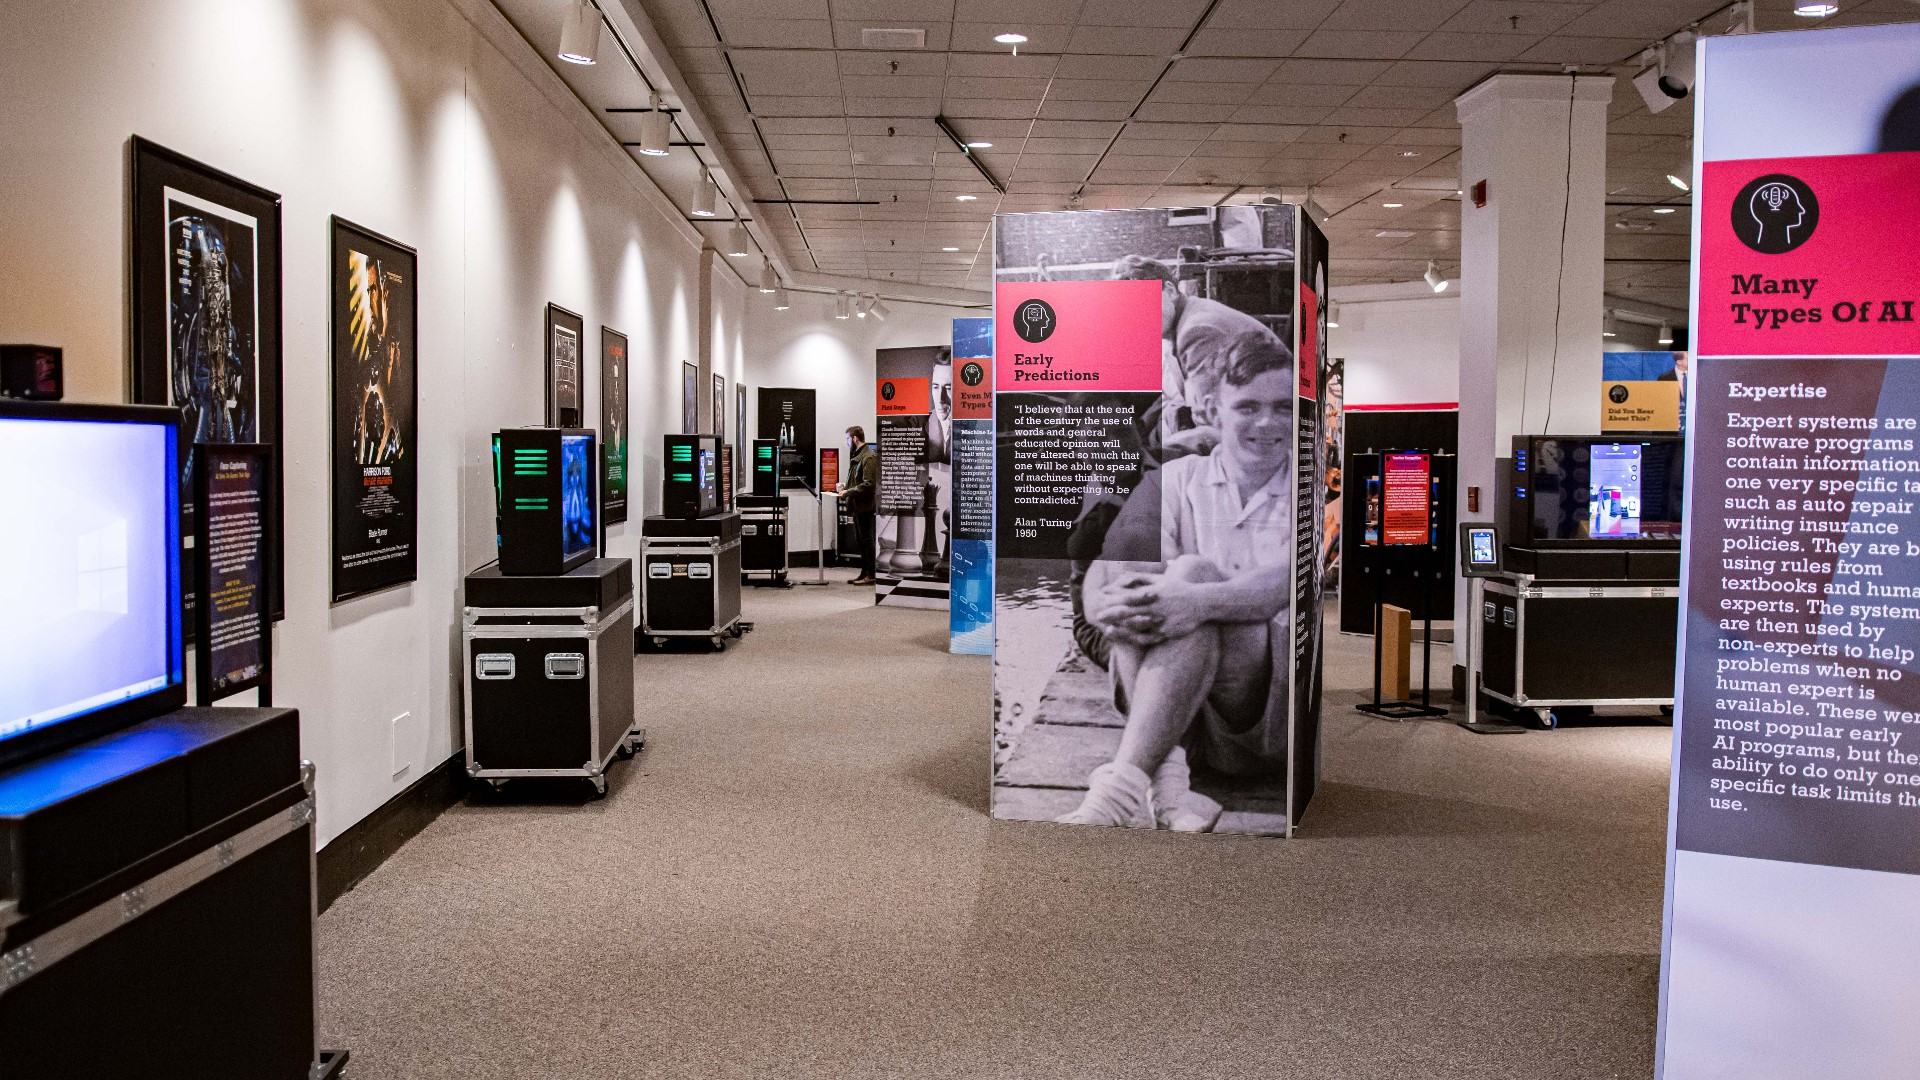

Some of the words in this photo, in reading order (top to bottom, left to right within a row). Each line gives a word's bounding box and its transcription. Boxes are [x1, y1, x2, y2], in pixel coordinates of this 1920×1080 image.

[1731, 274, 1818, 299] Many
[1731, 303, 1822, 329] Types
[1832, 301, 1872, 322] Of
[1878, 301, 1914, 322] AI
[1014, 354, 1053, 368] Early
[1015, 369, 1099, 381] Predictions
[1729, 383, 1827, 401] Expertise
[961, 401, 986, 409] Types
[1025, 405, 1062, 413] believe
[1065, 405, 1082, 413] that
[1097, 405, 1112, 413] the
[1116, 405, 1135, 413] end
[1044, 418, 1081, 426] century
[1727, 413, 1792, 431] Expert
[1799, 416, 1878, 432] systems
[1885, 419, 1916, 429] are
[1015, 428, 1044, 436] words
[1047, 428, 1065, 436] and
[1068, 428, 1106, 438] general
[1015, 439, 1060, 447] educated
[1063, 439, 1099, 449] opinion
[1727, 434, 1809, 449] software
[1815, 439, 1913, 453] programs
[1091, 451, 1118, 459] much
[1121, 451, 1139, 459] that
[1727, 455, 1798, 469] contain
[1804, 455, 1920, 471] information
[1035, 462, 1052, 470] will
[1055, 462, 1068, 470] be
[1071, 462, 1092, 470] able
[1107, 463, 1137, 472] speak
[1015, 473, 1024, 481] of
[1027, 473, 1072, 481] machines
[1075, 473, 1115, 484] thinking
[1726, 478, 1761, 489] one
[1767, 479, 1813, 494] very
[1820, 477, 1897, 495] specific
[1053, 485, 1102, 495] expecting
[1725, 495, 1769, 509] such
[1776, 500, 1796, 510] as
[1803, 499, 1845, 512] auto
[1851, 499, 1913, 516] repair
[1015, 518, 1036, 526] Alan
[1040, 519, 1072, 529] Turing
[1724, 515, 1794, 535] writing
[1800, 521, 1898, 534] insurance
[1016, 529, 1036, 537] 1950
[1723, 536, 1804, 552] policies.
[1812, 538, 1862, 557] They
[1868, 544, 1900, 555] are
[1723, 556, 1776, 575] using
[1781, 558, 1831, 573] rules
[1836, 559, 1883, 575] from
[1722, 577, 1817, 593] textbooks
[1824, 581, 1861, 595] and
[1721, 599, 1799, 614] experts.
[1807, 600, 1843, 615] The
[1850, 605, 1920, 620] system
[1720, 619, 1749, 630] are
[1756, 618, 1798, 633] then
[1805, 622, 1853, 636] used
[1859, 623, 1885, 641] by
[1718, 639, 1837, 657] non-experts
[1845, 644, 1862, 657] to
[1868, 644, 1914, 664] help
[1717, 657, 1809, 674] problems
[1816, 663, 1870, 679] when
[1877, 669, 1901, 680] no
[1716, 675, 1781, 693] human
[1788, 684, 1853, 699] expert
[1859, 686, 1875, 699] is
[1716, 698, 1809, 715] available.
[1817, 703, 1877, 720] These
[1714, 719, 1760, 732] most
[1765, 723, 1844, 739] popular
[1850, 728, 1902, 746] early
[1713, 735, 1735, 750] AI
[1740, 741, 1840, 761] programs,
[1848, 746, 1880, 762] but
[1887, 749, 1920, 765] the
[1712, 756, 1773, 776] ability
[1779, 762, 1796, 775] to
[1803, 763, 1827, 778] do
[1834, 767, 1878, 785] only
[1884, 773, 1920, 786] one
[1711, 778, 1785, 794] specific
[1792, 783, 1831, 799] task
[1837, 786, 1891, 804] limits
[1898, 792, 1920, 806] th
[1710, 798, 1747, 811] use.
